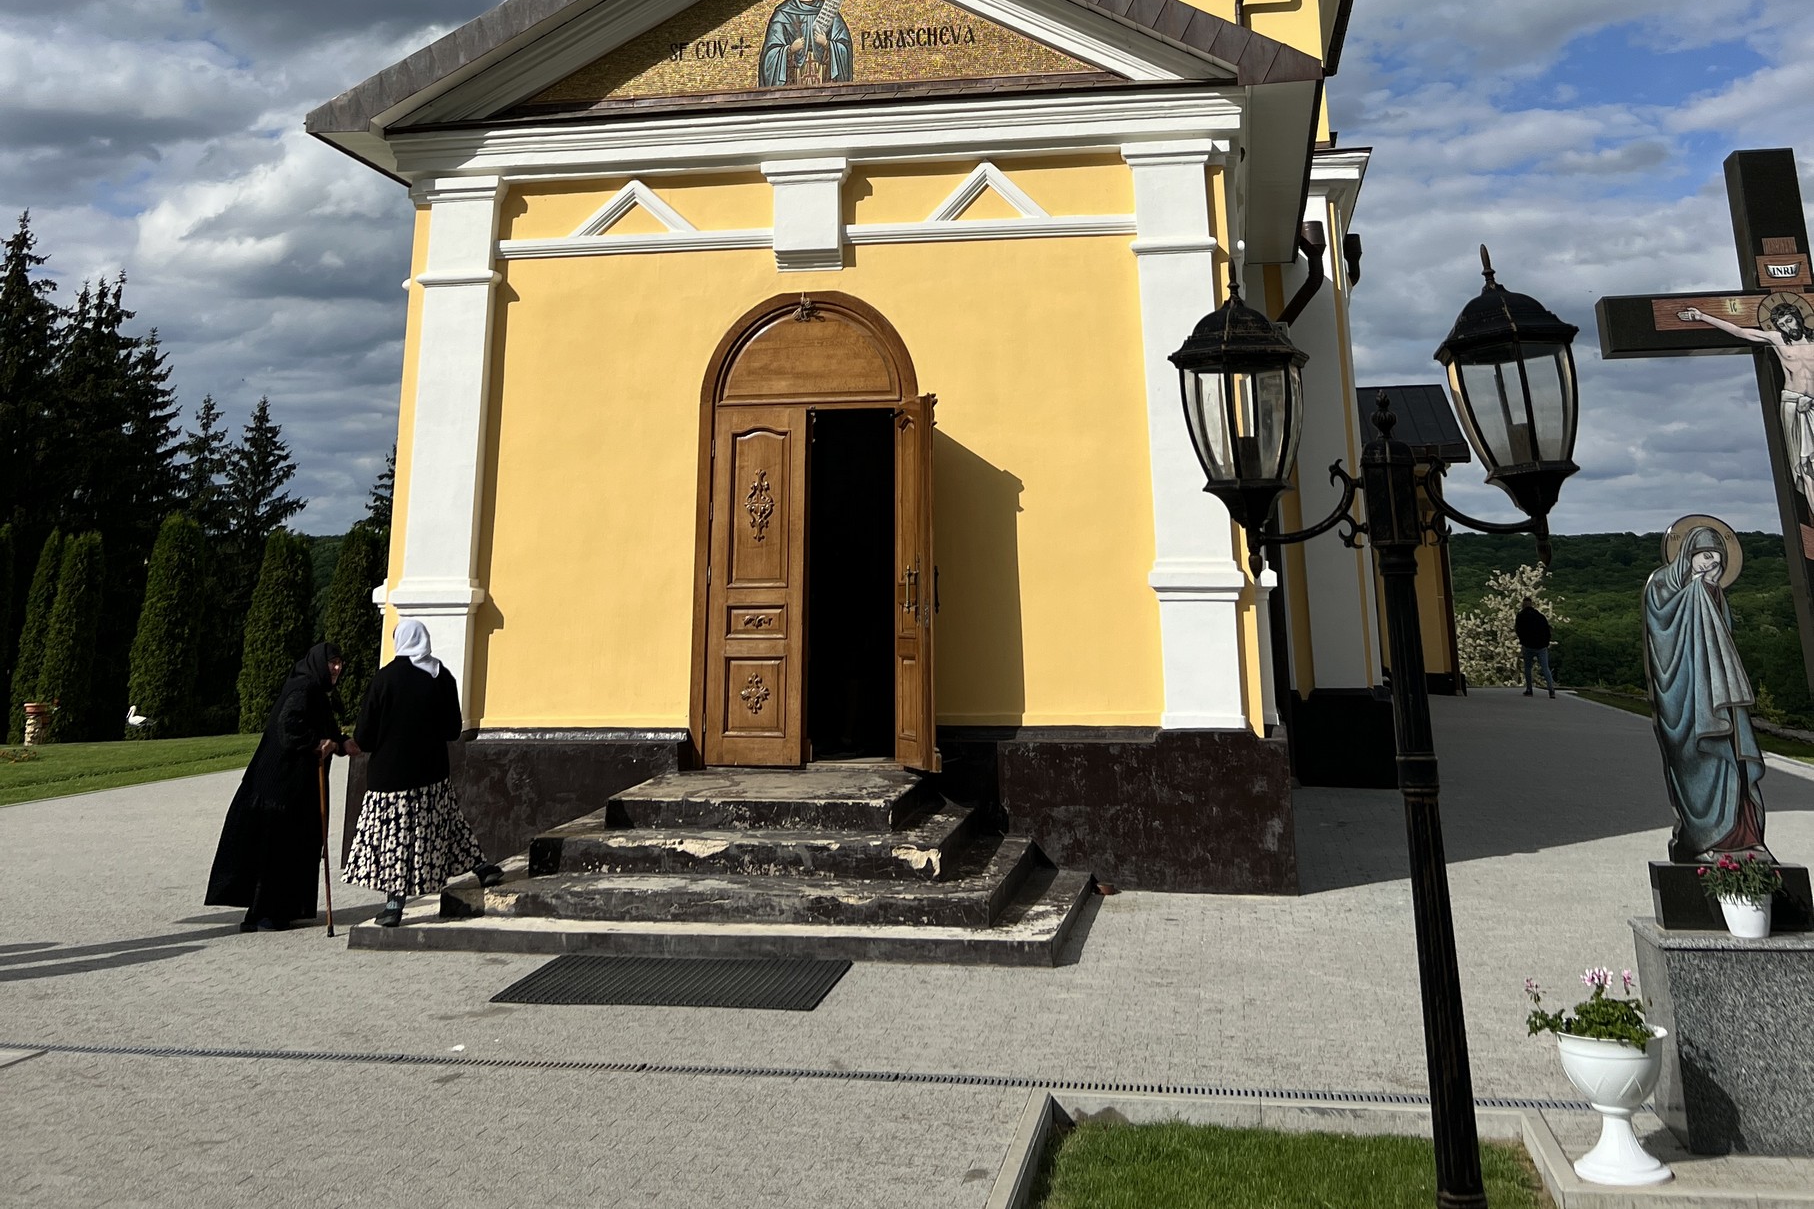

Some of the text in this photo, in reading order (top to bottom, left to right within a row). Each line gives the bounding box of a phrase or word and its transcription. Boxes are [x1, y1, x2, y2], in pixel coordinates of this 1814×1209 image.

[861, 25, 976, 50] PARASCHEVA
[696, 39, 728, 59] CUV
[1772, 266, 1794, 276] INRI
